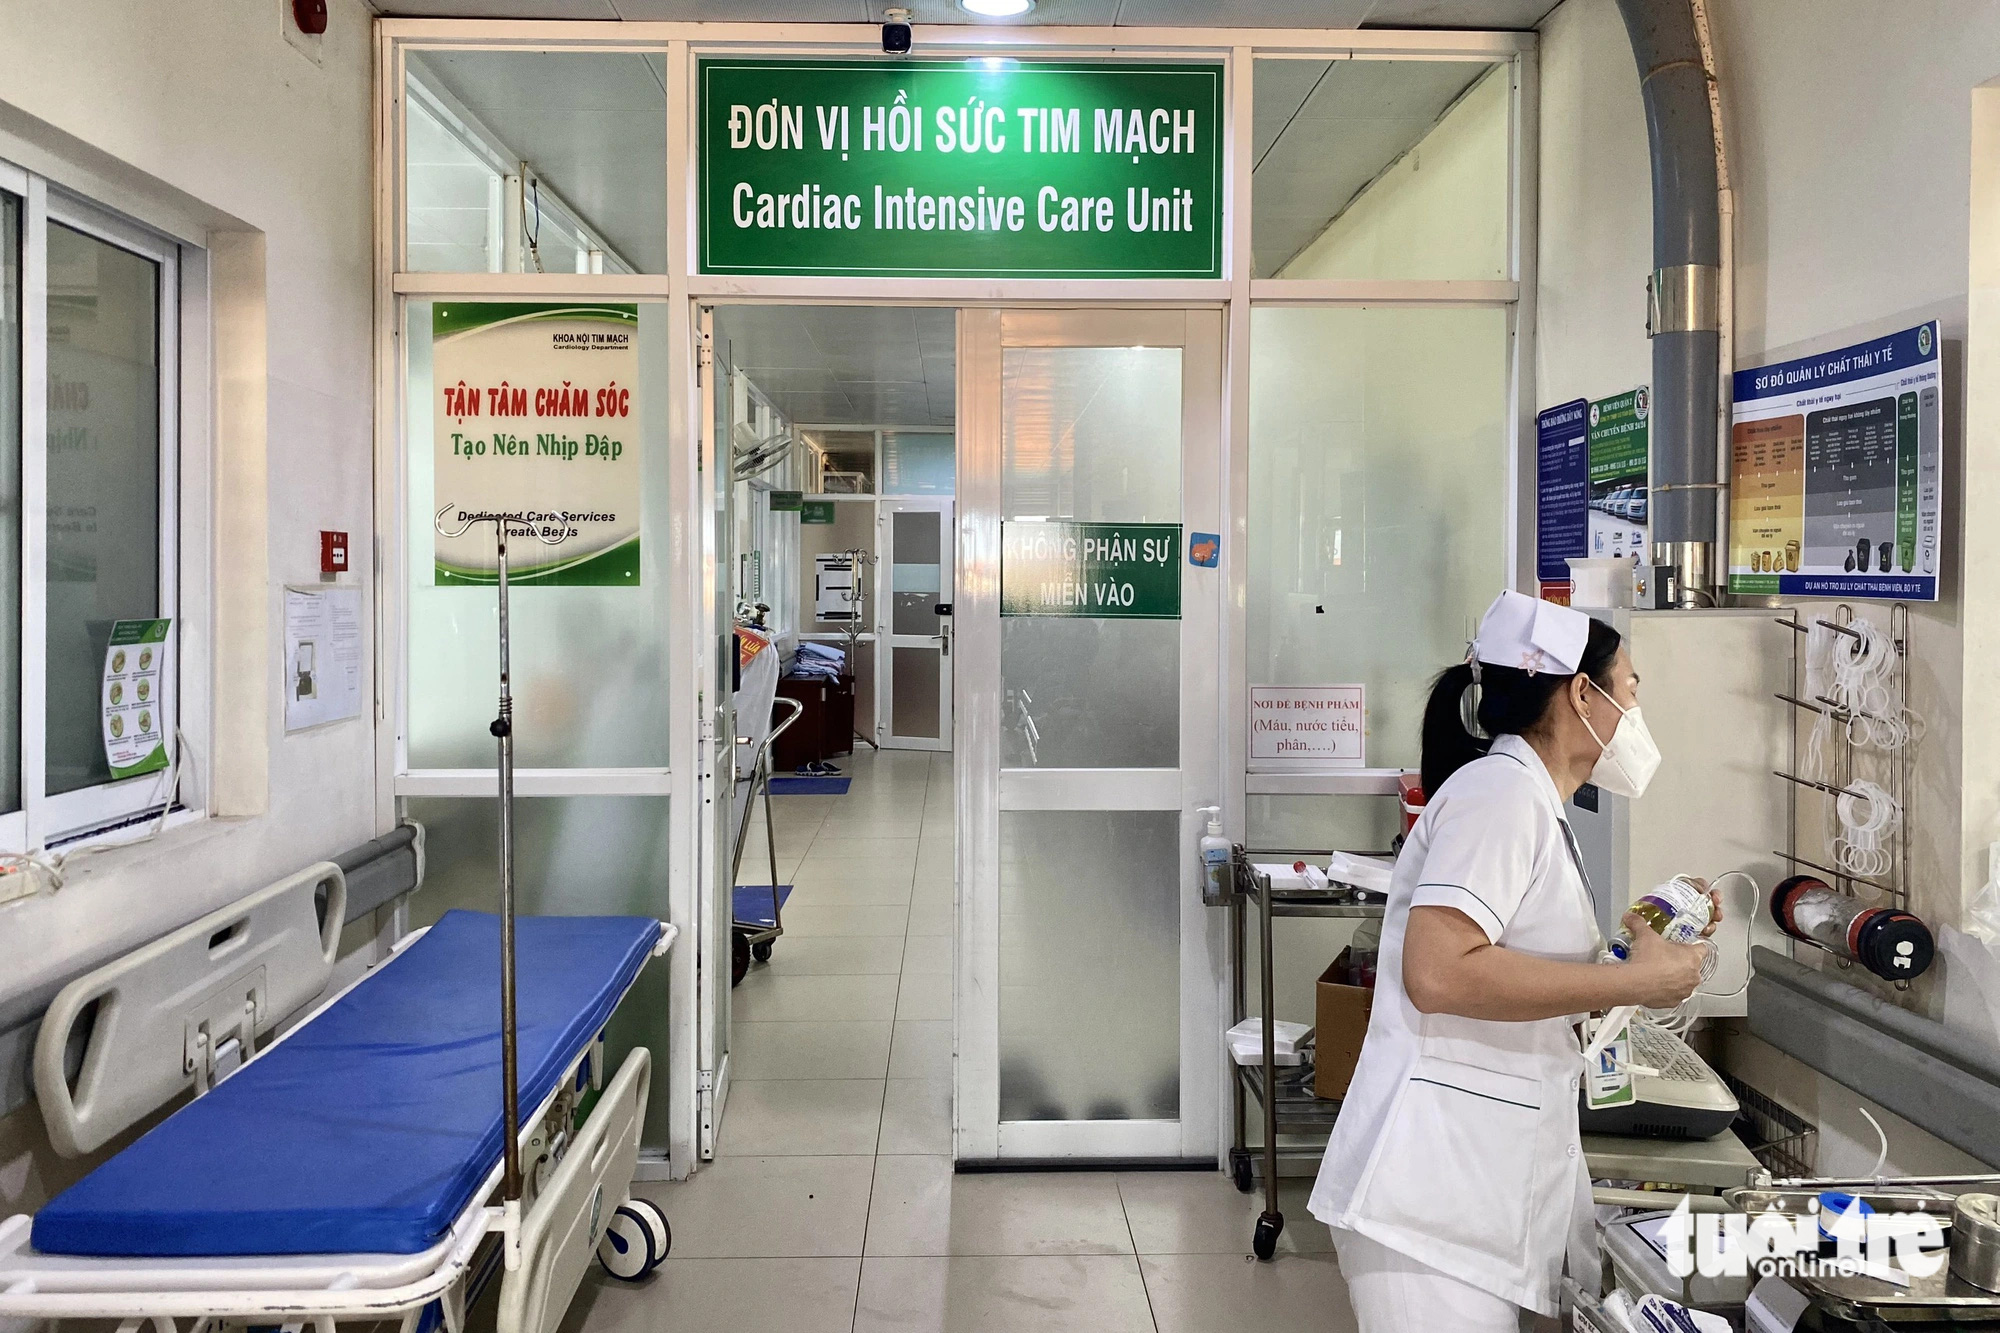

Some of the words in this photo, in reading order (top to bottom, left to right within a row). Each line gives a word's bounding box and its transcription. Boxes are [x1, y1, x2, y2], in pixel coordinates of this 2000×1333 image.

[728, 98, 803, 152] ĐƠN
[816, 105, 849, 161] VỊ
[863, 89, 922, 153] HỒI
[935, 96, 1006, 154] SỨC
[1017, 108, 1080, 153] TIM
[1094, 108, 1195, 164] MẠCH
[732, 182, 861, 230] Cardiac
[874, 184, 1024, 232] Intensive
[1037, 186, 1114, 233] Care
[1126, 187, 1193, 233] Unit
[553, 334, 575, 342] KHOA
[576, 333, 590, 344] NỘI
[592, 334, 605, 342] TIM
[607, 334, 629, 345] MẠCH
[1755, 375, 1768, 390] SƠ
[1786, 366, 1812, 384] QUẢN
[1814, 362, 1826, 379] LÝ
[1828, 355, 1851, 375] CHẤT
[1852, 350, 1872, 369] THẢI
[1874, 351, 1881, 364] Y
[1882, 343, 1893, 362] TẾ
[444, 380, 481, 424] TẬN
[487, 381, 527, 417] TÂM
[535, 380, 588, 417] CHĂM
[595, 381, 629, 417] SÓC
[451, 434, 486, 460] Tạo
[493, 434, 529, 455] Nên
[536, 434, 579, 461] Nhịp
[585, 434, 622, 461] Đập
[526, 511, 556, 521] Care
[561, 511, 615, 521] Services
[496, 528, 537, 537] reate
[1084, 532, 1136, 566] PHẬN
[1143, 535, 1171, 567] SỰ
[1041, 572, 1087, 606] MIỄN
[1094, 577, 1135, 607] VÀO
[1254, 700, 1273, 709] NƠI
[1294, 700, 1324, 711] BỆNH
[1254, 719, 1292, 733] (Máu,
[1296, 719, 1327, 731] nước
[1331, 716, 1358, 733] tiểu,
